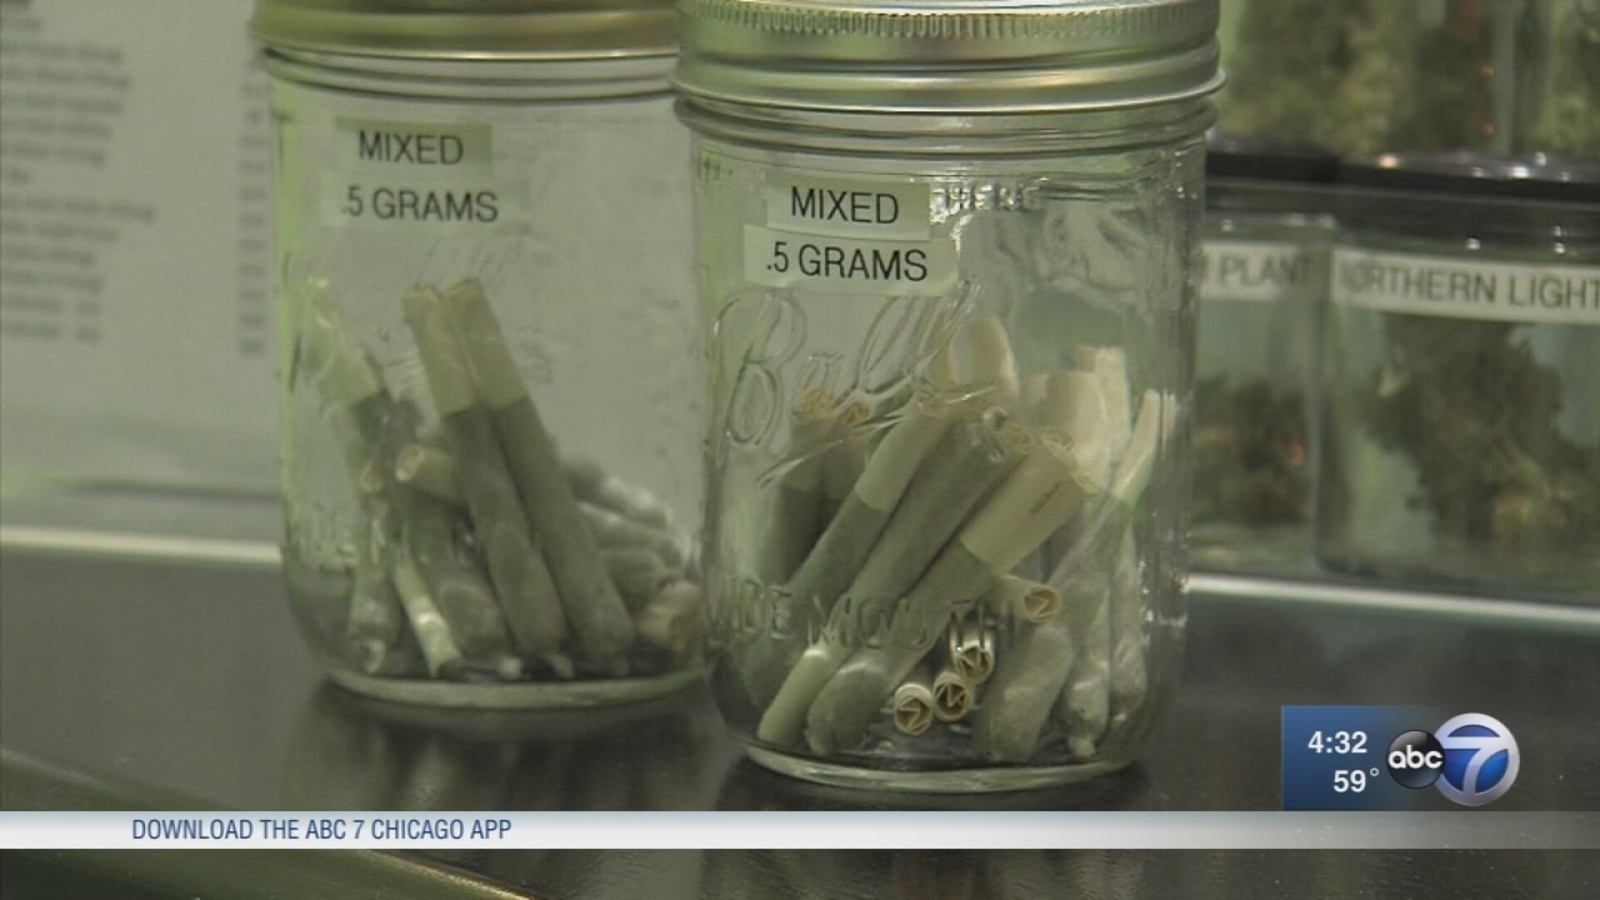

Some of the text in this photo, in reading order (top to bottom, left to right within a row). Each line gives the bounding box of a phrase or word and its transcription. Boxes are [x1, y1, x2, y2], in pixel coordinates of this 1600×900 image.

[358, 130, 465, 166] MIXED
[372, 188, 499, 223] GRAMS
[790, 186, 900, 225] MIXED
[766, 241, 928, 282] .5 GRAMS
